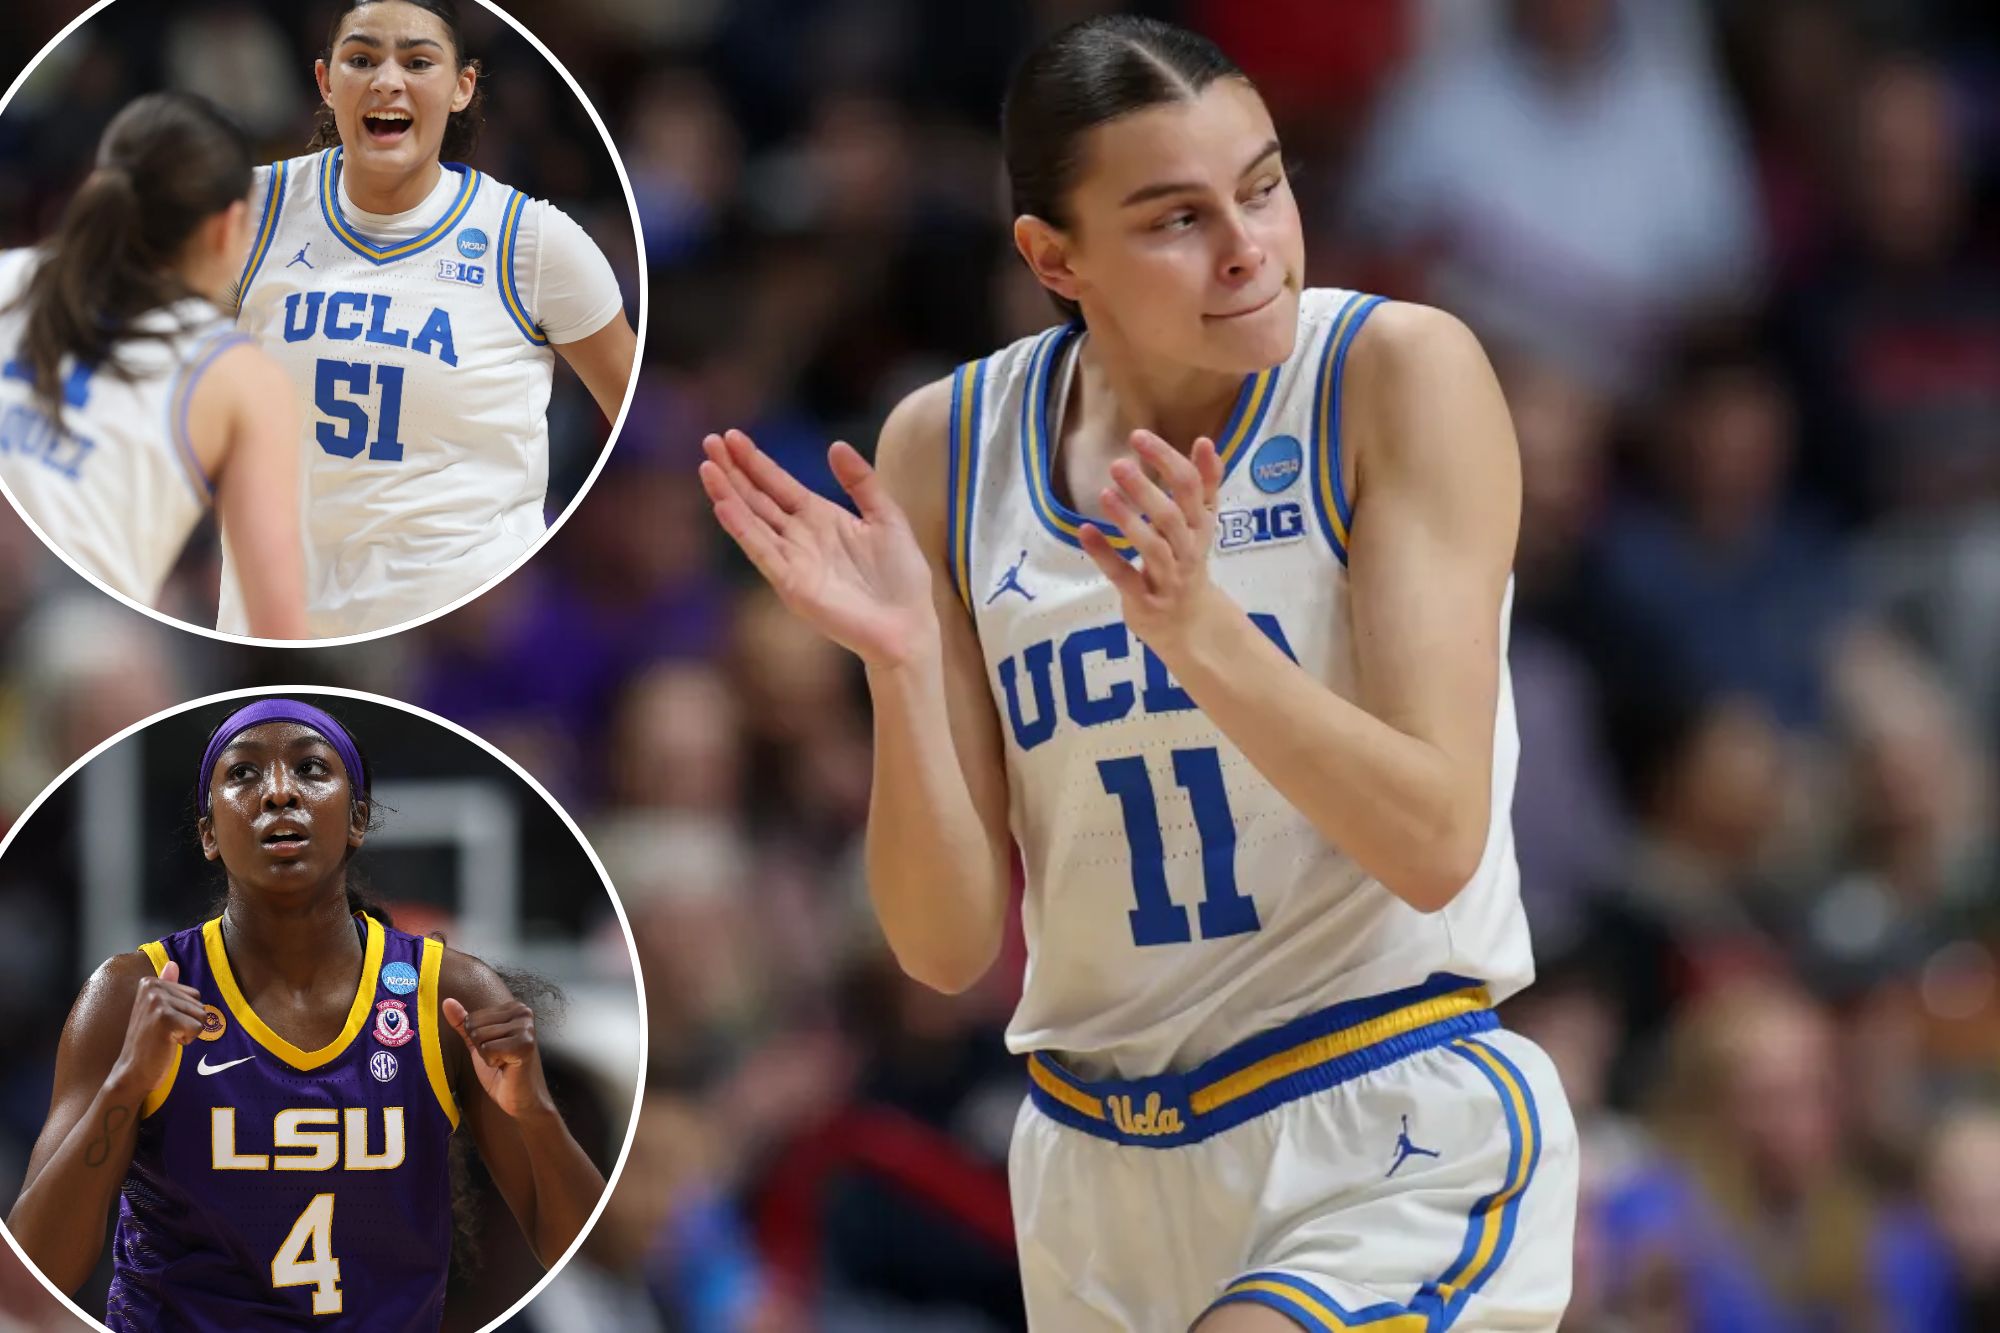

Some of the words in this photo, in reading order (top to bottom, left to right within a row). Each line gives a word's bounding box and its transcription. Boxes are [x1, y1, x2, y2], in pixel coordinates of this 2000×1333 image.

[284, 291, 458, 368] UCLA
[315, 358, 405, 462] 51
[998, 612, 1300, 752] UCL
[1096, 746, 1261, 946] 11
[372, 1053, 396, 1079] SEC
[211, 1106, 405, 1171] LSU
[271, 1193, 342, 1315] 4
